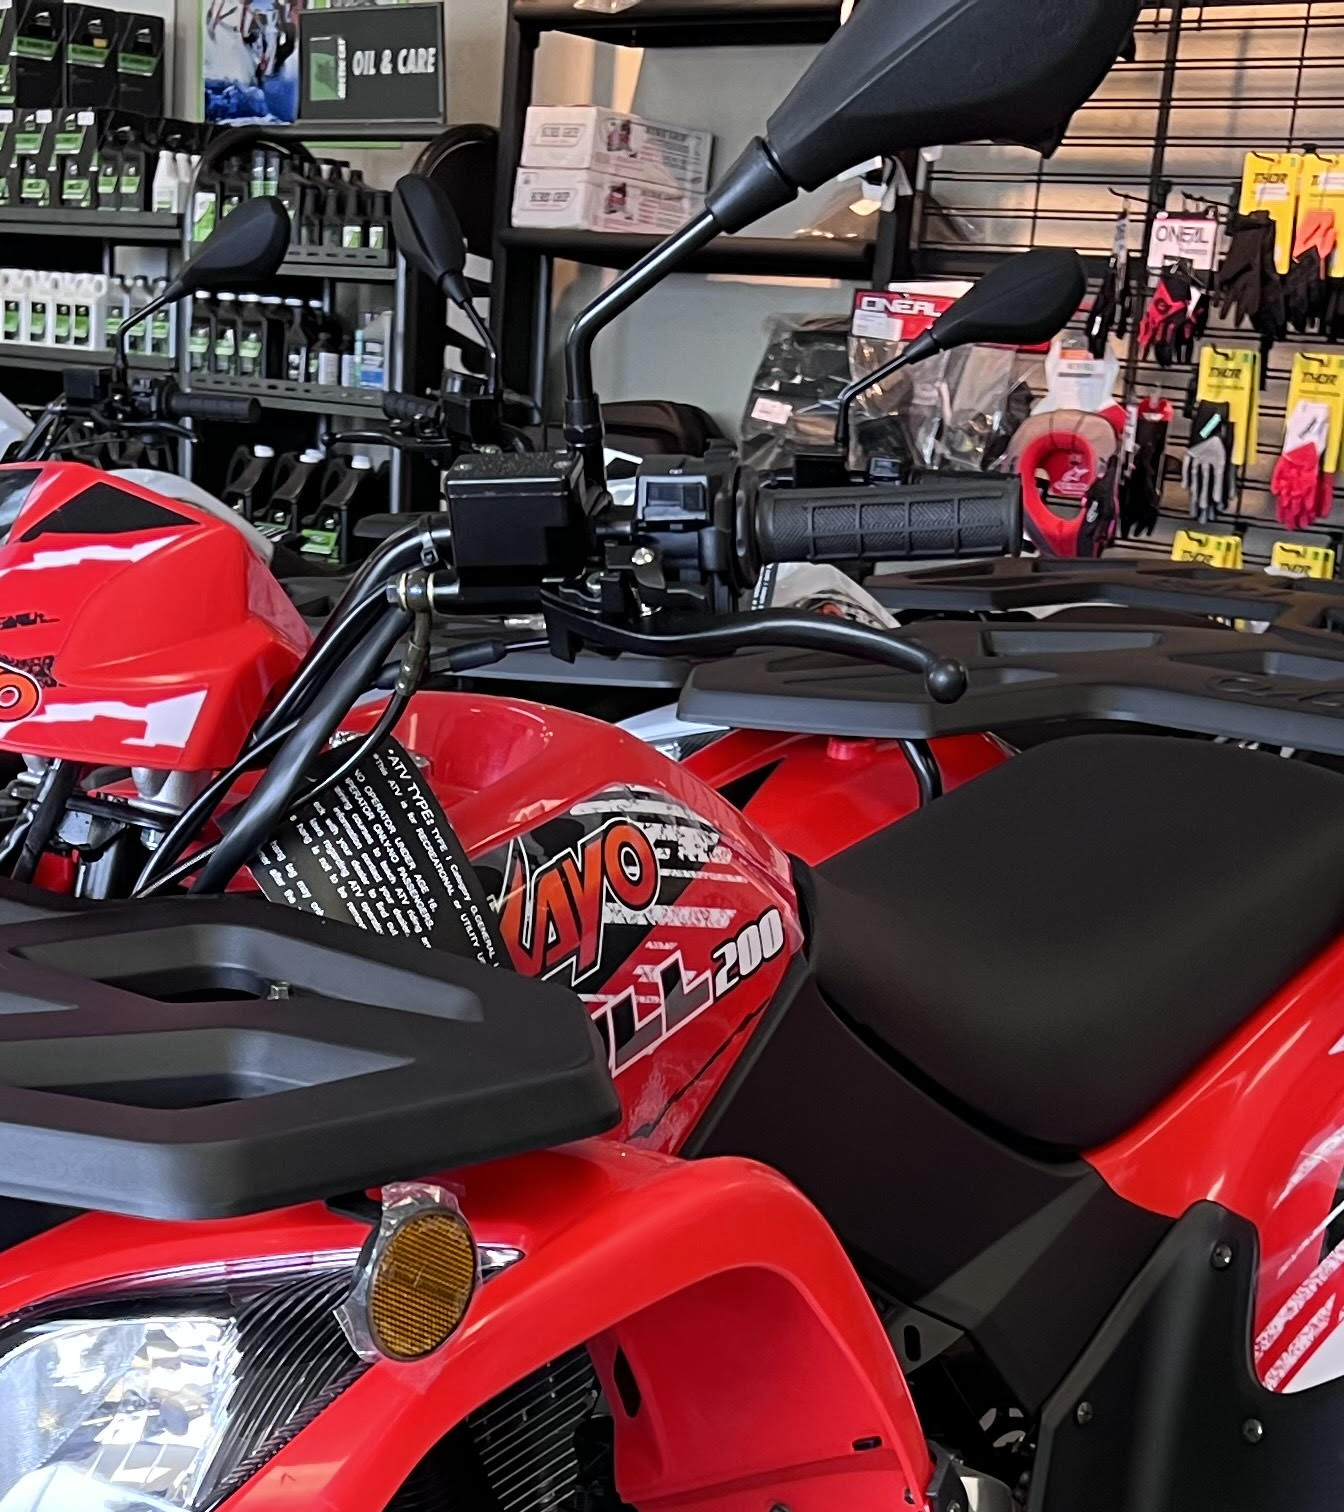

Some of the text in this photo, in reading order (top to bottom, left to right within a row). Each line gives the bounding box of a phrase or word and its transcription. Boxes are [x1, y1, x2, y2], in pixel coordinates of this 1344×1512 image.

[352, 47, 437, 76] OIL & CARE
[1208, 366, 1242, 380] THOR
[1301, 372, 1339, 386] THOR
[364, 785, 397, 835] OPERATOR
[394, 836, 417, 871] UNDER
[413, 874, 430, 895] AGE
[387, 752, 412, 779] ATV
[407, 782, 435, 826] TYPE:
[431, 827, 448, 852] TYPE
[269, 868, 286, 887] after
[283, 888, 297, 904] the
[271, 840, 287, 862] hang
[285, 862, 298, 879] tag
[296, 880, 312, 899] may
[296, 823, 313, 845] hang
[311, 844, 321, 855] is
[318, 856, 333, 872] not
[329, 873, 339, 884] to
[336, 885, 348, 899] be
[309, 817, 325, 837] laws
[322, 839, 350, 878] regarding
[347, 880, 365, 897] ATV
[325, 818, 339, 836] with
[335, 837, 353, 856] your
[350, 859, 370, 885] dealer
[367, 888, 377, 899] to
[375, 901, 390, 919] find
[386, 921, 399, 936] out
[333, 807, 411, 937] information contact your dealer.
[351, 813, 374, 845] courses
[372, 847, 382, 858] to
[379, 860, 397, 885] teach
[394, 888, 410, 905] ATV
[406, 909, 423, 934] riding
[387, 780, 403, 796] ATV
[400, 800, 408, 809] is
[407, 811, 418, 824] for
[415, 827, 455, 897] RECREATIONAL
[453, 899, 462, 909] or
[460, 913, 480, 947] UTILITY
[591, 907, 785, 1079] LL 200
